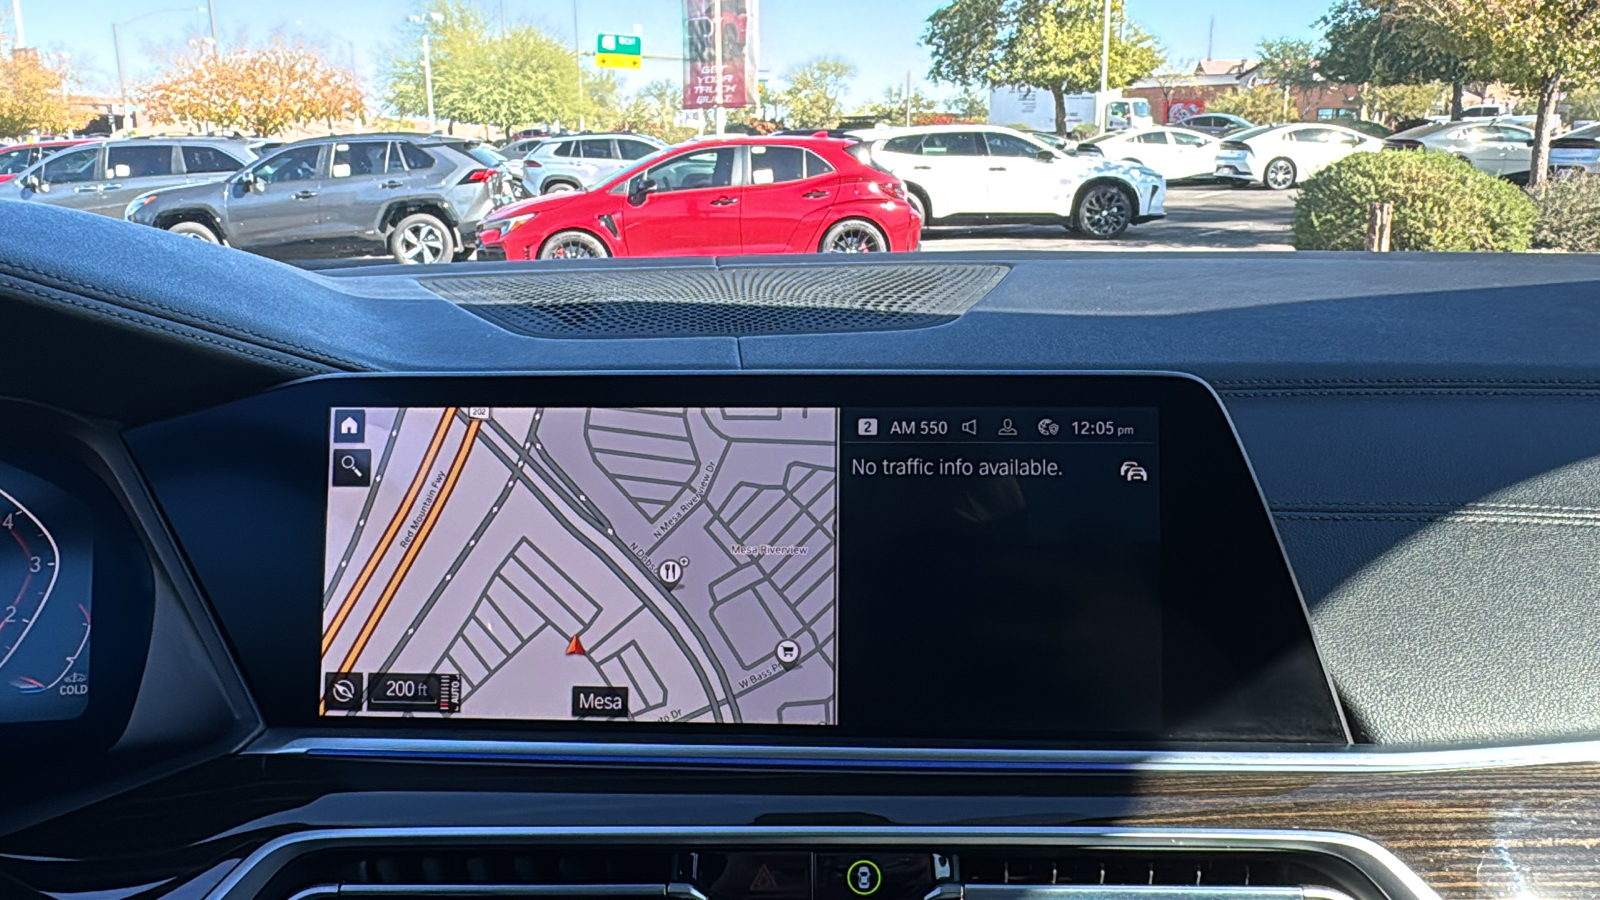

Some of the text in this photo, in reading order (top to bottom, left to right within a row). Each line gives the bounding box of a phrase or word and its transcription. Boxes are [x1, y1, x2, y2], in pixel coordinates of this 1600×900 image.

[697, 75, 734, 85] YOR
[473, 407, 486, 416] 202
[890, 421, 948, 435] AM 550
[1072, 421, 1134, 437] 12:05 pm
[852, 458, 1063, 476] No traffic info available.
[653, 461, 716, 539] N Mesa Riverview Dr
[399, 470, 446, 549] Red Mountain Fwy
[2, 513, 14, 530] 4
[629, 542, 639, 551] N
[731, 544, 808, 554] Mesa Riverview
[29, 556, 41, 573] 3
[6, 605, 16, 622] 2
[738, 679, 749, 689] W
[750, 668, 772, 685] Bass
[59, 684, 89, 696] COLD
[386, 680, 428, 697] 200 ft
[451, 681, 461, 704] AUTO
[579, 692, 623, 710] Mesa
[670, 708, 682, 719] Dr
